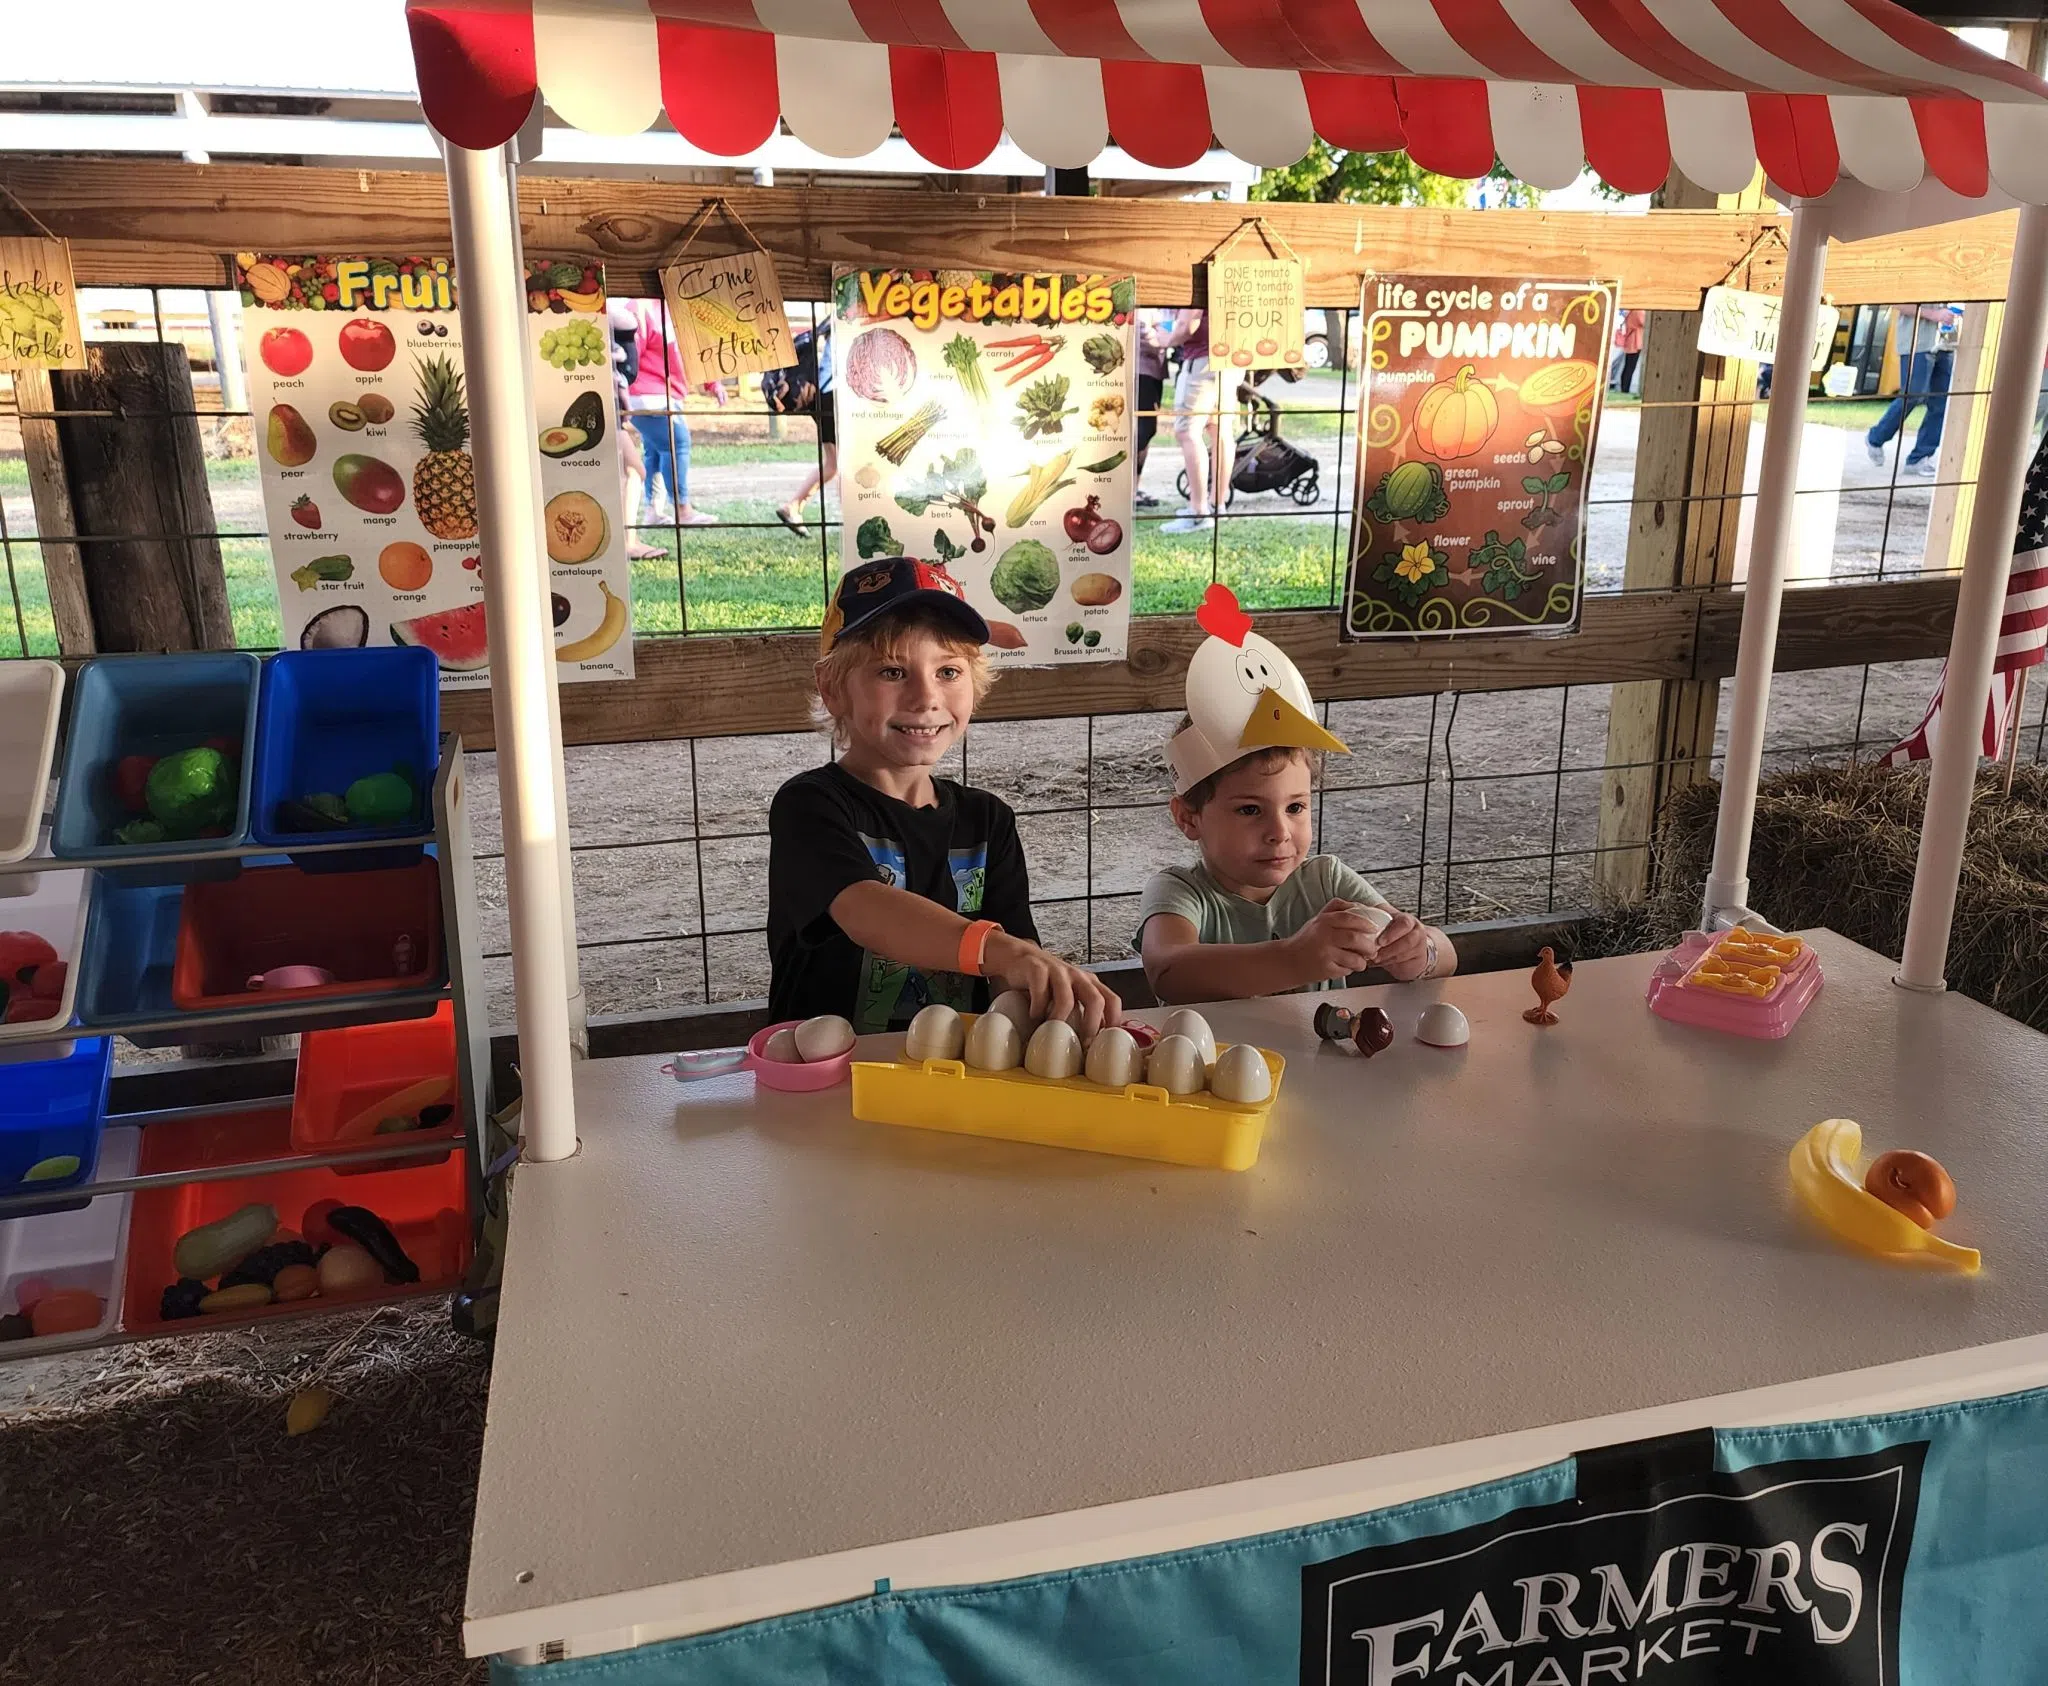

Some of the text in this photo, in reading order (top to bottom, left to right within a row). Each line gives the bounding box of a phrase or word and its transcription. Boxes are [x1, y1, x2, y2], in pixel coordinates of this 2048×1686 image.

[1224, 267, 1291, 280] ONE tomato
[335, 260, 459, 309] Frui
[678, 263, 757, 300] Come
[1224, 281, 1294, 293] TWO tomato
[860, 271, 1115, 330] Vegetables
[1216, 295, 1295, 308] THREE tomato
[1377, 282, 1549, 318] life cycle of a
[734, 290, 777, 323] Ear
[1225, 310, 1284, 329] FOUR
[406, 338, 463, 349] blueberries
[1399, 320, 1577, 359] PUMPKIN
[697, 328, 780, 375] often?
[985, 350, 1015, 358] carrots
[355, 374, 383, 385] apple
[563, 373, 596, 383] grapes
[1377, 370, 1436, 385] pumpkin
[273, 379, 305, 389] peach
[1086, 379, 1125, 388] artichoke
[366, 427, 387, 437] kiwi
[1082, 434, 1129, 442] cauliflower
[561, 458, 601, 467] avocado
[1493, 451, 1527, 464] seeds
[281, 470, 305, 479] pear
[1093, 475, 1112, 483] okra
[1444, 467, 1479, 481] green
[1450, 478, 1501, 492] pumpkin
[858, 491, 882, 502] garlic
[1497, 498, 1535, 512] sprout
[931, 510, 952, 519] beets
[363, 517, 397, 526] mango
[283, 531, 339, 542] strawberry
[1433, 534, 1471, 547] flower
[433, 541, 480, 552] pineapple
[1072, 546, 1086, 554] red
[1068, 553, 1090, 562] onion
[1531, 553, 1557, 565] vine
[551, 568, 603, 578] cantaloupe
[321, 582, 365, 591] star fruit
[392, 594, 427, 603] orange
[1084, 608, 1109, 617] potato
[1000, 650, 1026, 659] potato
[1054, 648, 1083, 656] Brussels
[1084, 647, 1111, 656] sprouts
[580, 662, 614, 671] banana
[1351, 1522, 1868, 1686] FARMERS
